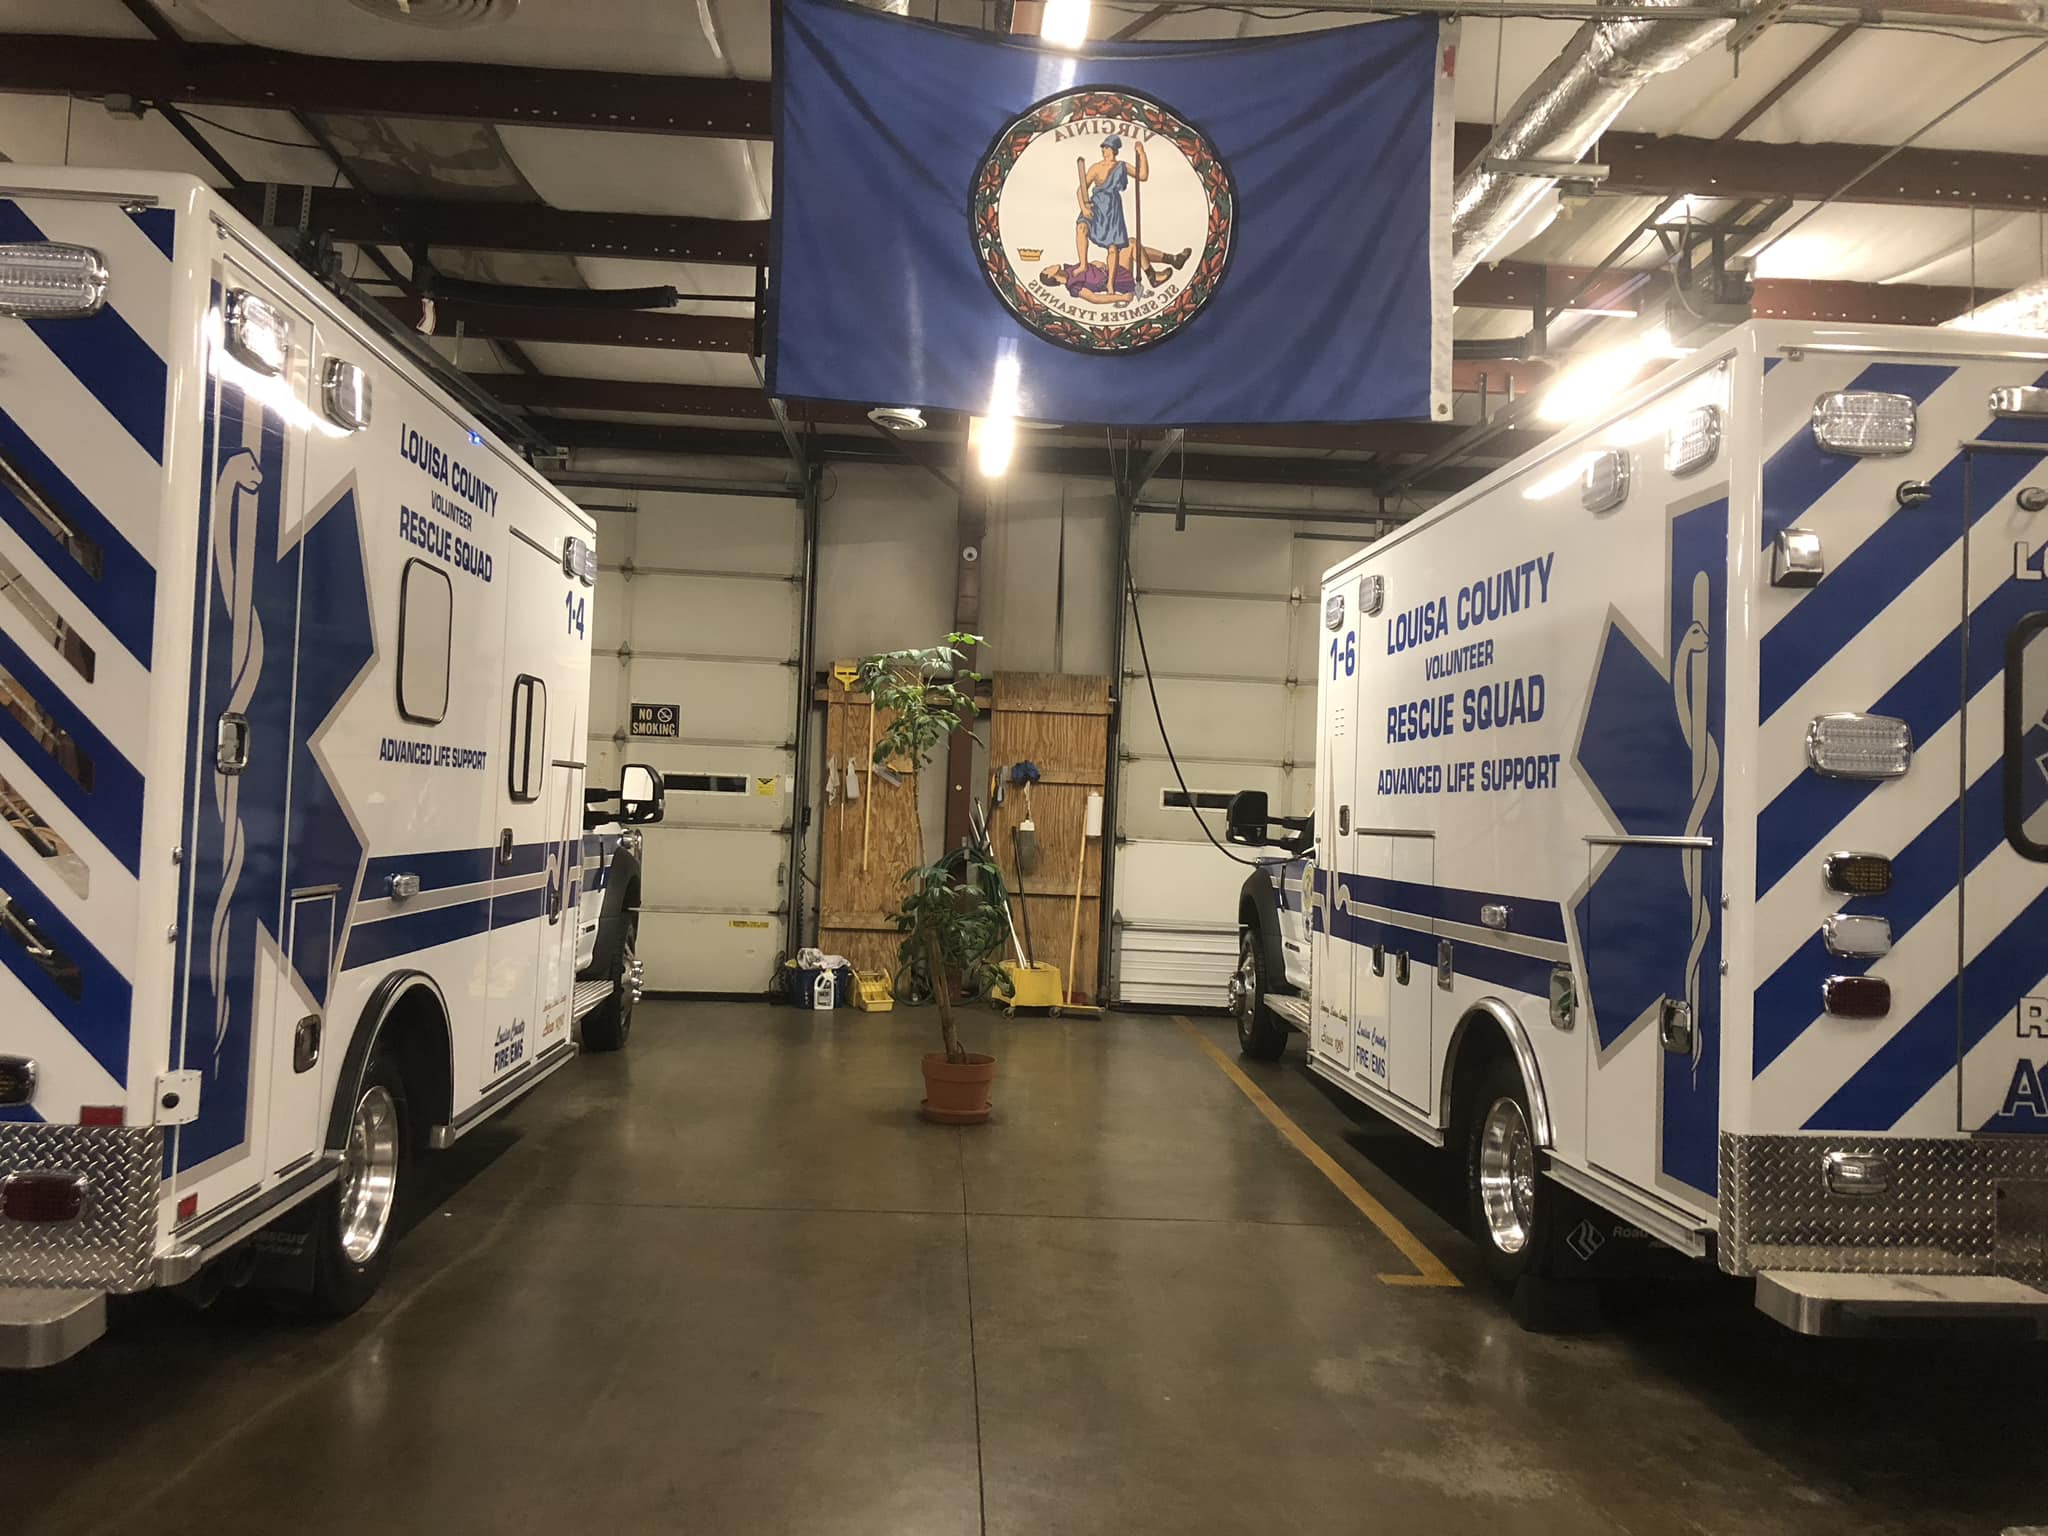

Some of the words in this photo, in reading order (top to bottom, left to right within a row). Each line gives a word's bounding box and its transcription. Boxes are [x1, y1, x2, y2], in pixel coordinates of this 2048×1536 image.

[400, 423, 449, 483] LOUISA
[451, 461, 498, 517] COUNTY
[431, 490, 473, 532] VOLUNTEER
[400, 505, 451, 563] RESCUE
[454, 539, 493, 583] SQUAD
[2015, 541, 2048, 580] L
[565, 589, 586, 641] 1-4
[1387, 596, 1449, 656] LOUISA
[1457, 551, 1555, 631] COUNTY
[1330, 630, 1356, 681] 1-6
[1425, 639, 1494, 681] VOLUNTEER
[632, 722, 676, 736] SMOKING
[639, 708, 653, 720] NO
[1387, 693, 1455, 744] RESCUE
[1462, 674, 1545, 733] SQUAD
[380, 737, 433, 767] ADVANCED
[434, 744, 451, 768] LIFE
[451, 746, 487, 771] SUPPORT
[1377, 764, 1442, 795] ADVANCED
[1447, 761, 1475, 793] LIFE
[1481, 753, 1561, 792] SUPPORT
